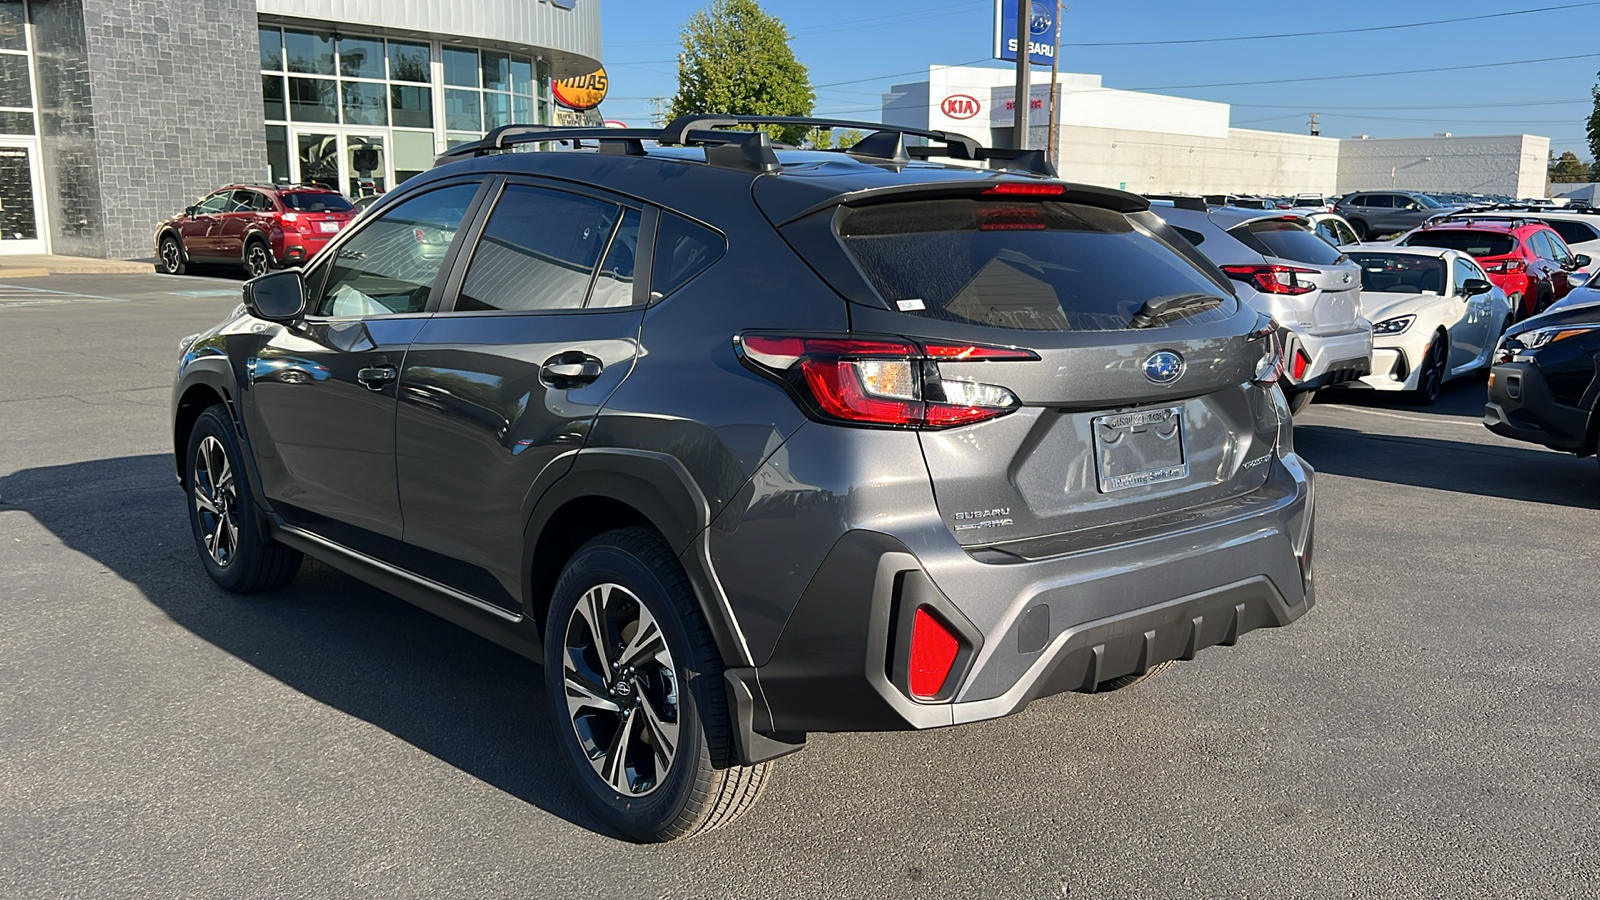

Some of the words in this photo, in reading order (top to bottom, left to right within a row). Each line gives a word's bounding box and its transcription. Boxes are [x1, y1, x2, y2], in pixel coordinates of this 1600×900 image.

[1008, 38, 1054, 58] SBARU
[555, 74, 607, 91] MIDAS
[947, 100, 974, 114] KIA
[955, 508, 1010, 520] SUBARU
